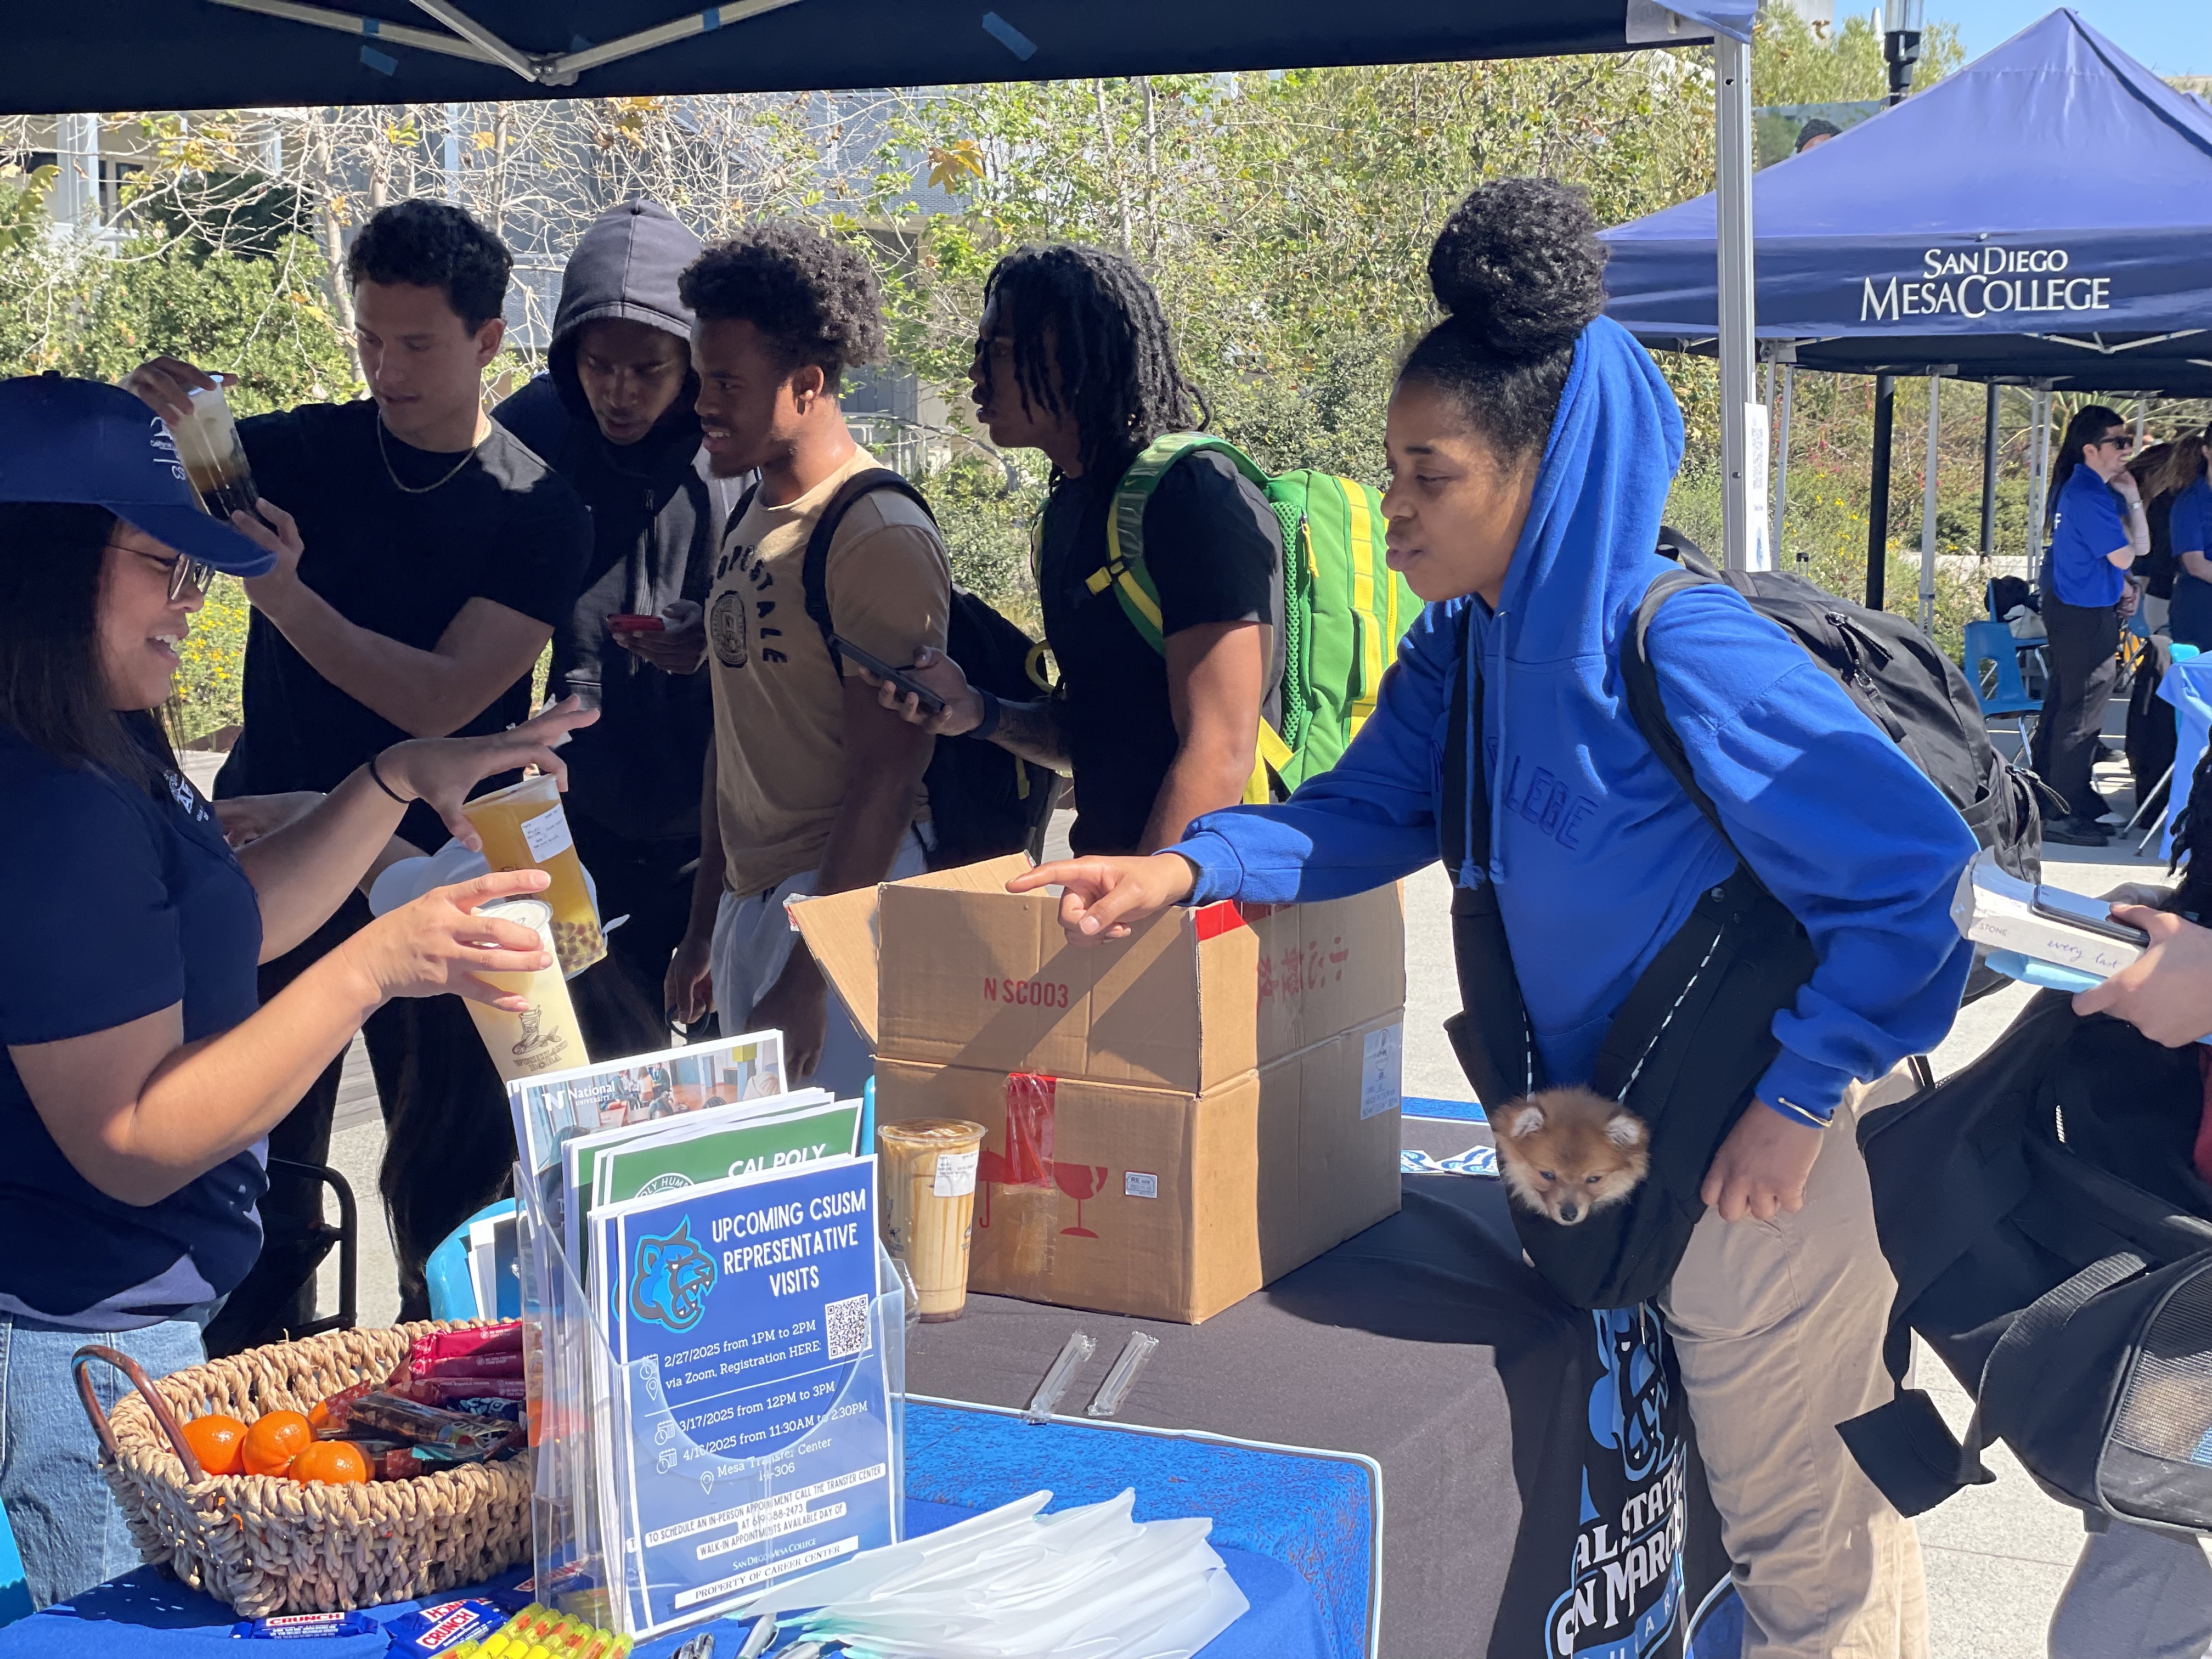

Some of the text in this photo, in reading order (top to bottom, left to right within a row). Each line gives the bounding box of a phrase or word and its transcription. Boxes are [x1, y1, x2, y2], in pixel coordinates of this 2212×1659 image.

[1922, 247, 2068, 279] SAN DIEGO
[1860, 275, 2111, 321] MESA COLLEGE
[1979, 922, 2008, 936] STONE
[2046, 939, 2085, 961] every
[513, 1040, 568, 1068] WUSHILAND
[528, 1054, 562, 1071] BOBA
[567, 1080, 616, 1101] National
[575, 1094, 611, 1107] UNIVERSITY
[641, 1181, 657, 1197] OLY
[712, 1188, 866, 1243] UPCOMING CSUSM
[723, 1223, 859, 1275] REPRESENTATIVE
[769, 1265, 819, 1297] VISITS
[664, 1319, 816, 1368] 2/27/2025 from 1PM to 2PM
[665, 1340, 821, 1389] via Zoom, Registration HERE:
[679, 1381, 836, 1432] 3/17/2025 from 12PM to 3PM
[740, 1430, 767, 1446] from
[769, 1414, 815, 1437] 11:30AM
[831, 1400, 868, 1421] 2:30PM
[718, 1459, 745, 1478] Mesa
[798, 1437, 832, 1455] Center
[648, 1465, 881, 1543] TO SCHEDULE AN IN-PERSON APPOINTMENT CALL THE TRANSFER CENTER
[700, 1504, 843, 1556] WALK-IN APPOINTMENTS AVAILABLE DAY OF
[742, 1519, 749, 1530] AT
[733, 1538, 816, 1570] SAN DIEGO MESA COLLEGE
[1576, 1523, 1618, 1570] AL
[696, 1545, 840, 1599] PROPERTY OF CAREER CENTER
[269, 1613, 340, 1625] CRUNCH
[422, 1611, 475, 1646] CRUNCH
